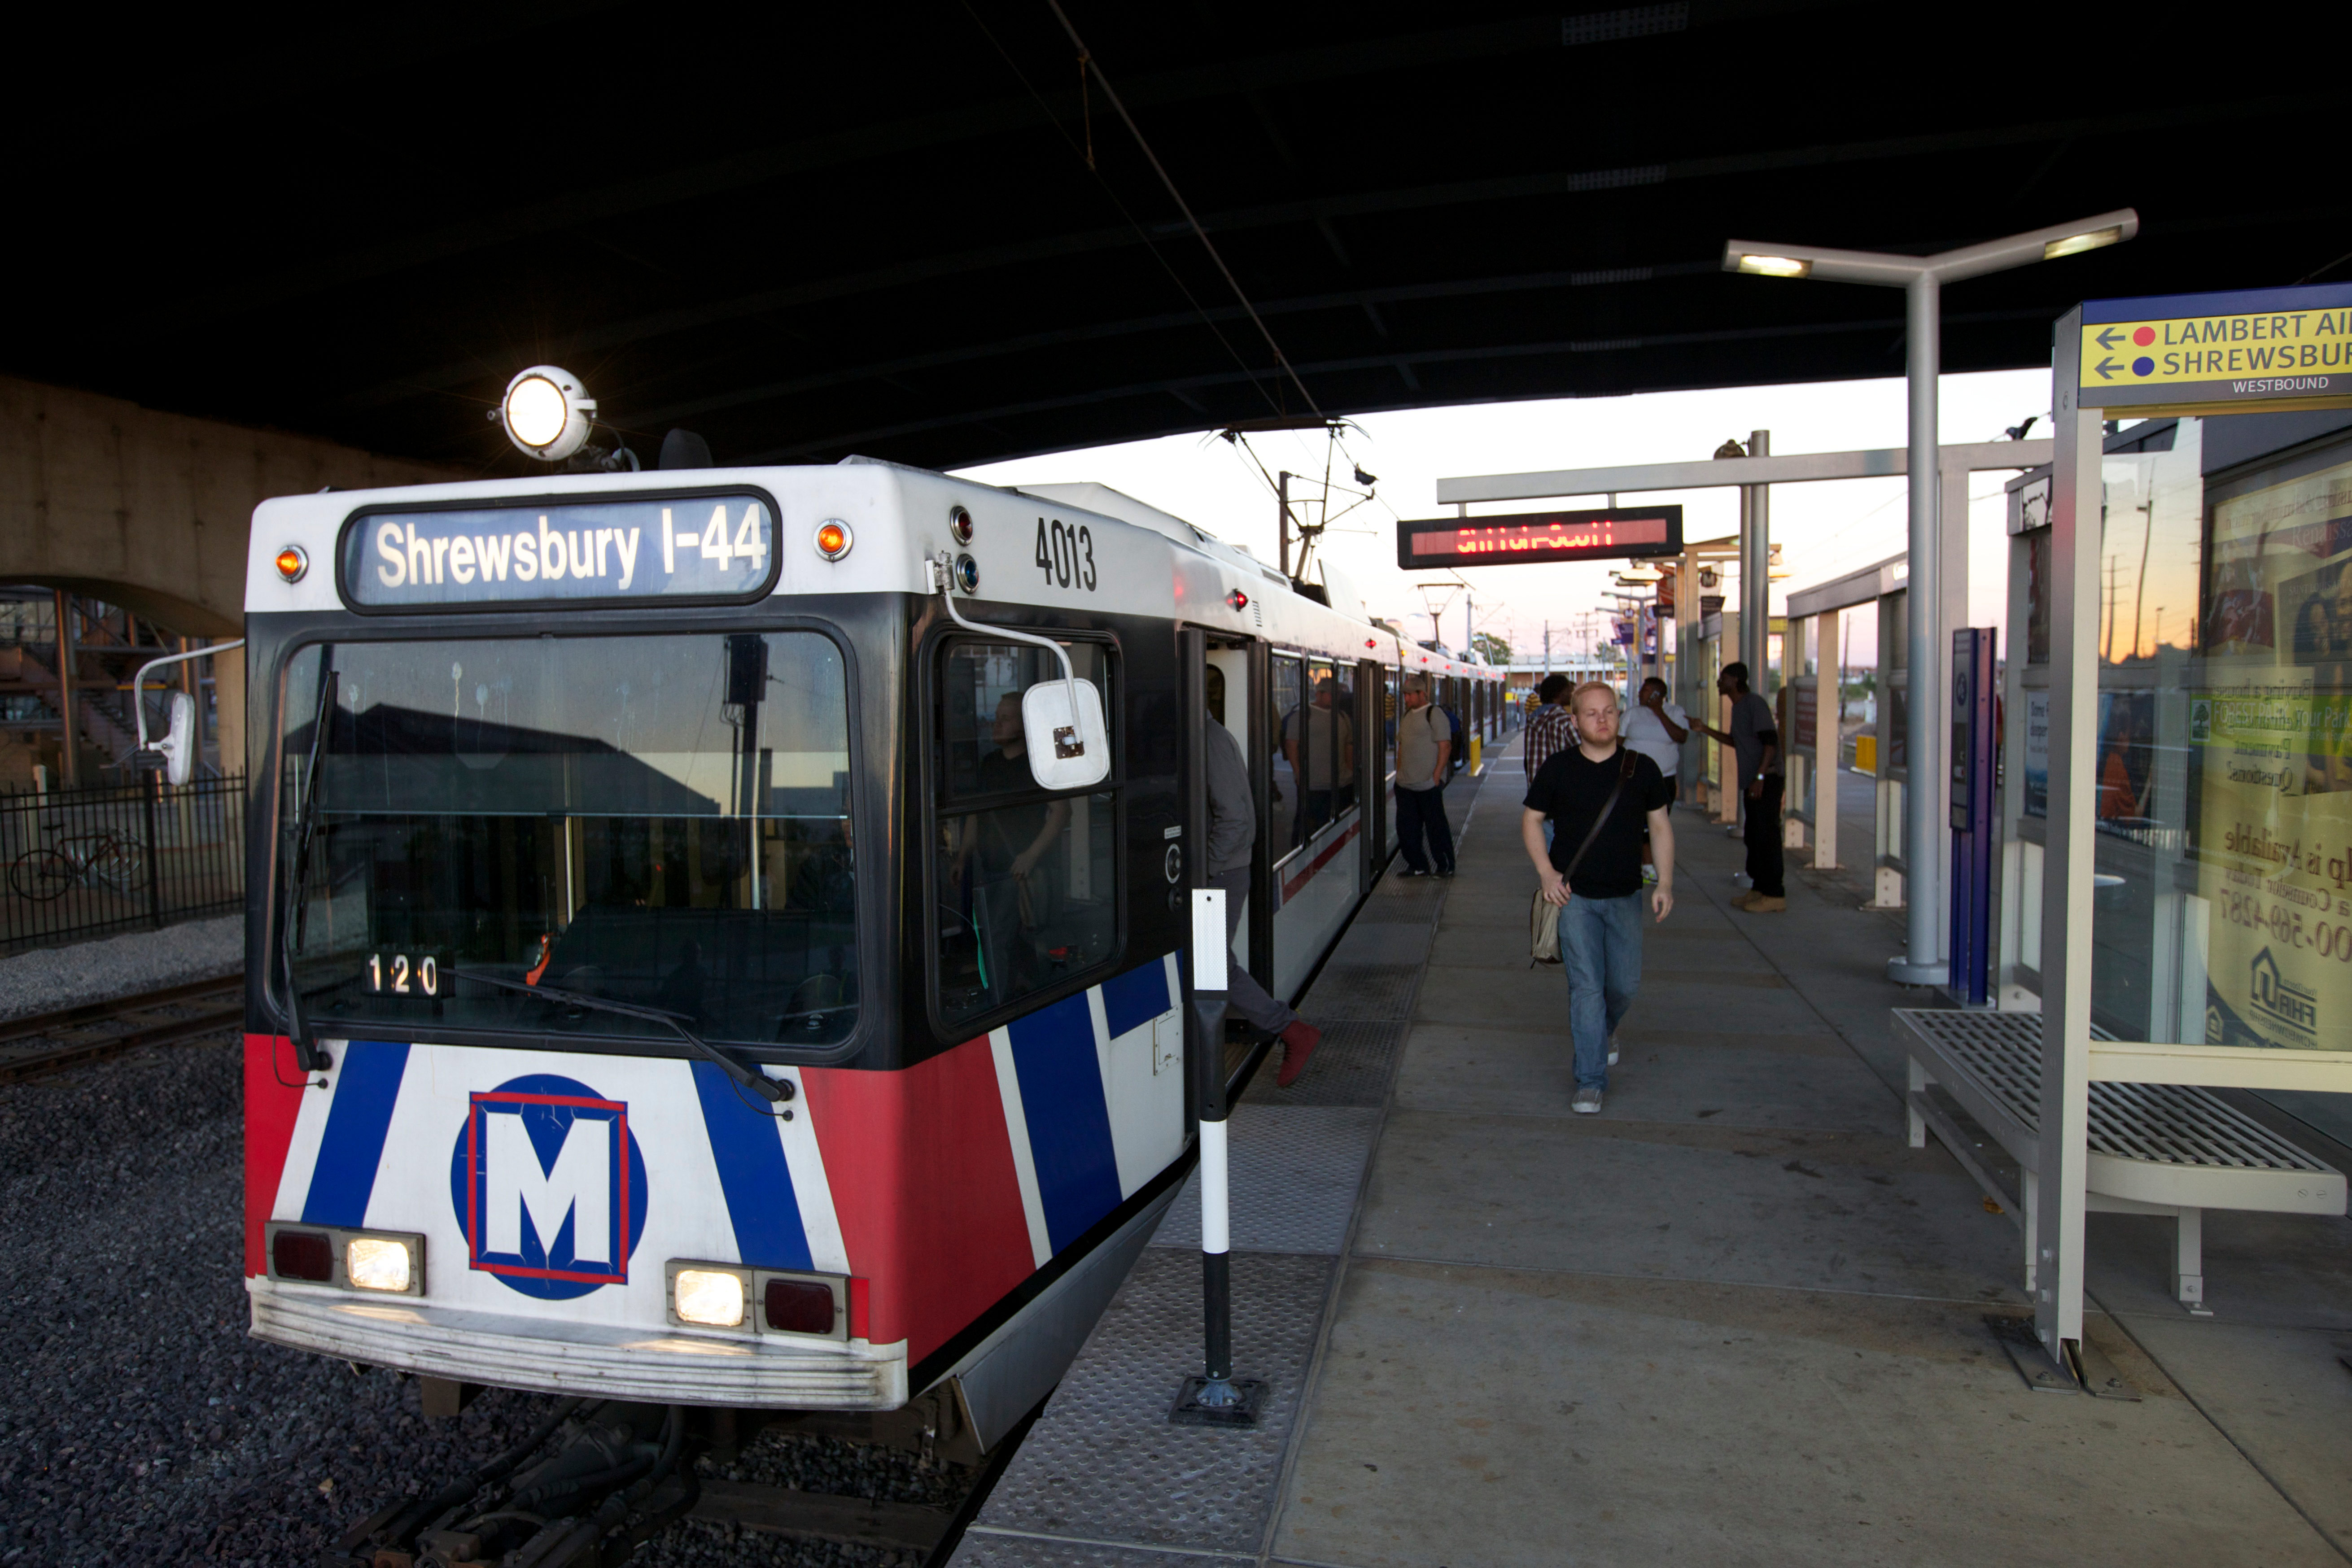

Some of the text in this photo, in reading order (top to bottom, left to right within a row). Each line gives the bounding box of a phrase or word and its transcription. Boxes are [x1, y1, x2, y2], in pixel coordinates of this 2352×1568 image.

[2164, 314, 2307, 345] LAMBERT
[2233, 377, 2329, 393] WESTBOUND
[377, 503, 766, 590] Shrewsbury I-44
[1036, 517, 1097, 592] 4013
[2214, 701, 2256, 724] FOREST
[2295, 706, 2322, 726] Your
[369, 953, 437, 996] 120
[486, 1112, 611, 1263] M
